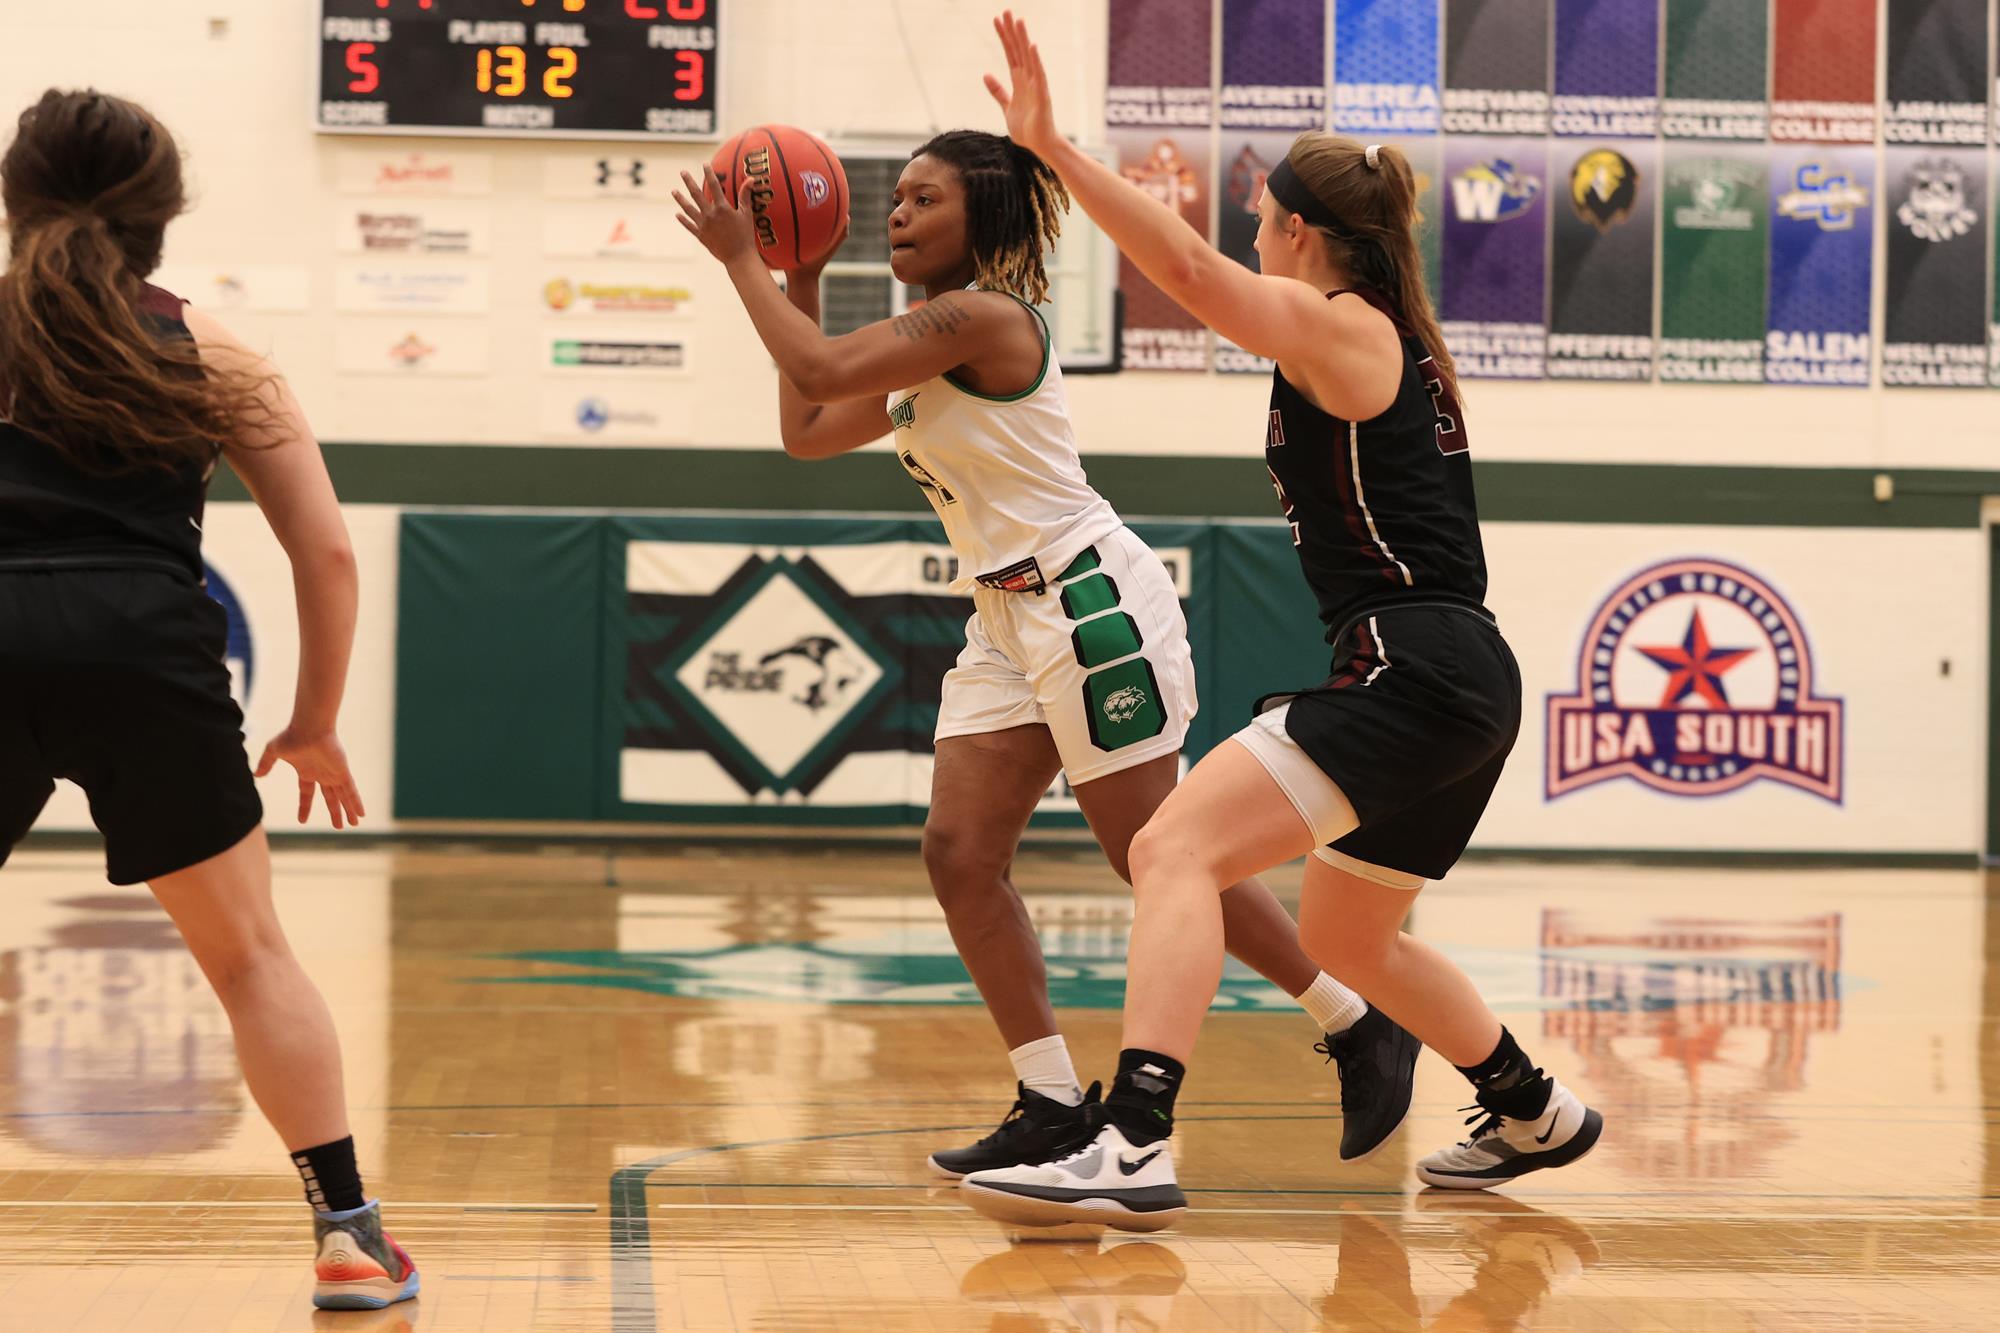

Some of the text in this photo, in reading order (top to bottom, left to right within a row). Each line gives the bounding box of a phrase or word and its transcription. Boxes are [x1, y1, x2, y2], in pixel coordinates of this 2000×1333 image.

[325, 19, 391, 41] FOULS
[449, 22, 589, 46] PLAYER FOUL
[648, 26, 714, 49] FOULS
[345, 43, 379, 93] 5
[477, 46, 577, 98] 13 2
[674, 50, 703, 100] 3
[1222, 86, 1325, 106] AVERETT
[1334, 84, 1437, 108] BEREA
[1444, 90, 1549, 110] BREVARD
[1107, 103, 1210, 125] COLLEGE
[1334, 109, 1437, 130] COLLEGE
[1444, 112, 1548, 132] COLLEGE
[1552, 114, 1657, 135] COLLEGE
[1662, 117, 1767, 138] COLLEGE
[1771, 119, 1874, 140] COLLEGE
[1885, 122, 1987, 142] COLLEGE
[1766, 331, 1869, 359] SALEM
[1661, 359, 1764, 381] COLLEGE
[1766, 361, 1869, 383] COLLEGE
[1882, 364, 1986, 385] COLLEGE
[711, 651, 740, 670] THE
[705, 669, 783, 692] PRIDE
[1563, 711, 1825, 777] USA SOUTH
